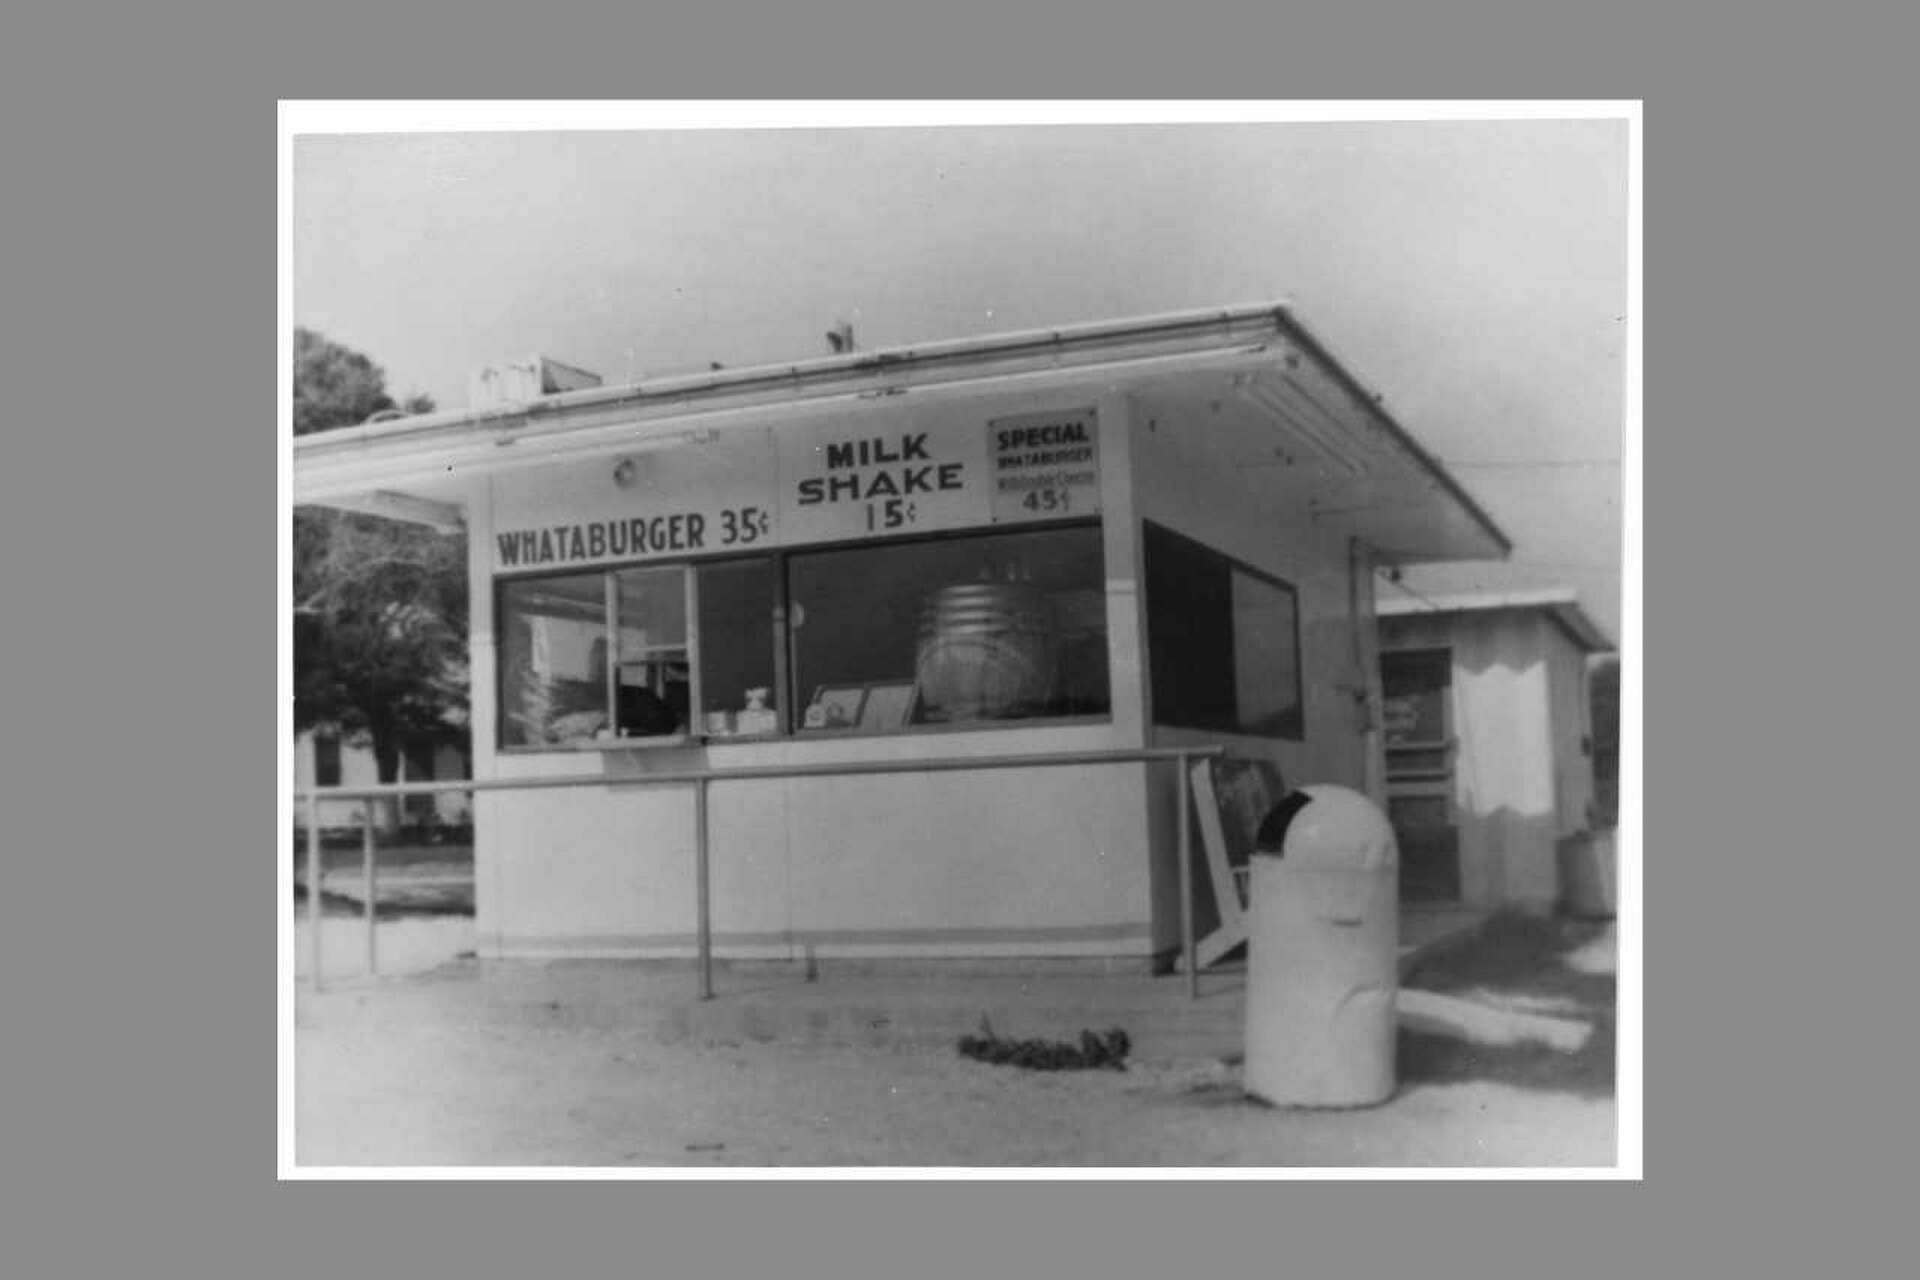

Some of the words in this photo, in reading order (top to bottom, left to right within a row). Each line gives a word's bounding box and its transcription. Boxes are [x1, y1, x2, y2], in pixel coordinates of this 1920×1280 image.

[827, 432, 930, 469] MILK
[998, 422, 1090, 450] SPECIAL
[799, 463, 964, 505] SHAKE
[498, 513, 705, 566] WHATABURGER
[720, 507, 769, 545] 35¢
